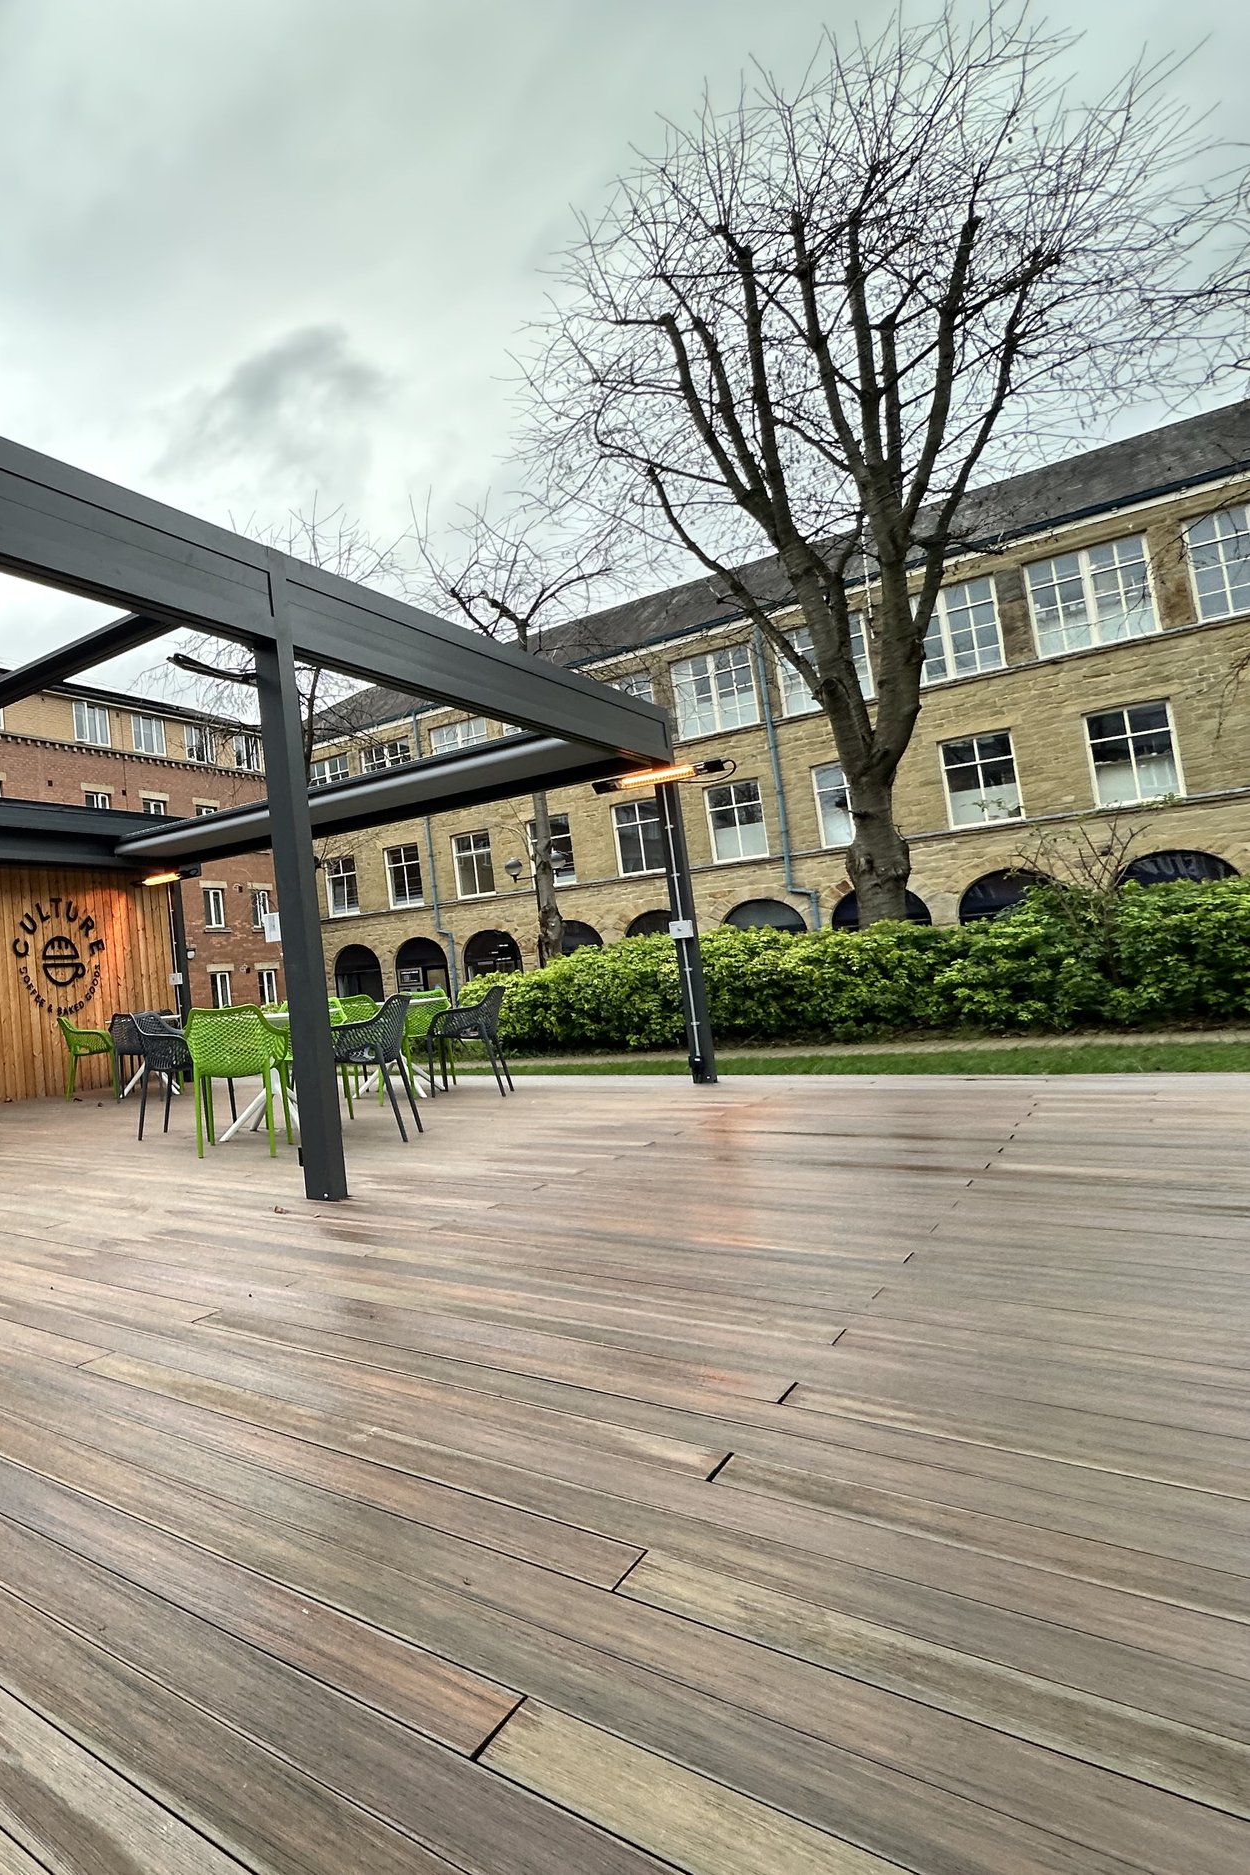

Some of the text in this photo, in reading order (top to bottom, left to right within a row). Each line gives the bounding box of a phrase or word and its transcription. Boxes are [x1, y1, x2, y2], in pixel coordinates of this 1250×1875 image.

[13, 898, 105, 957] CULTURE
[19, 964, 101, 1016] COFFEE & BAKED GOODS
